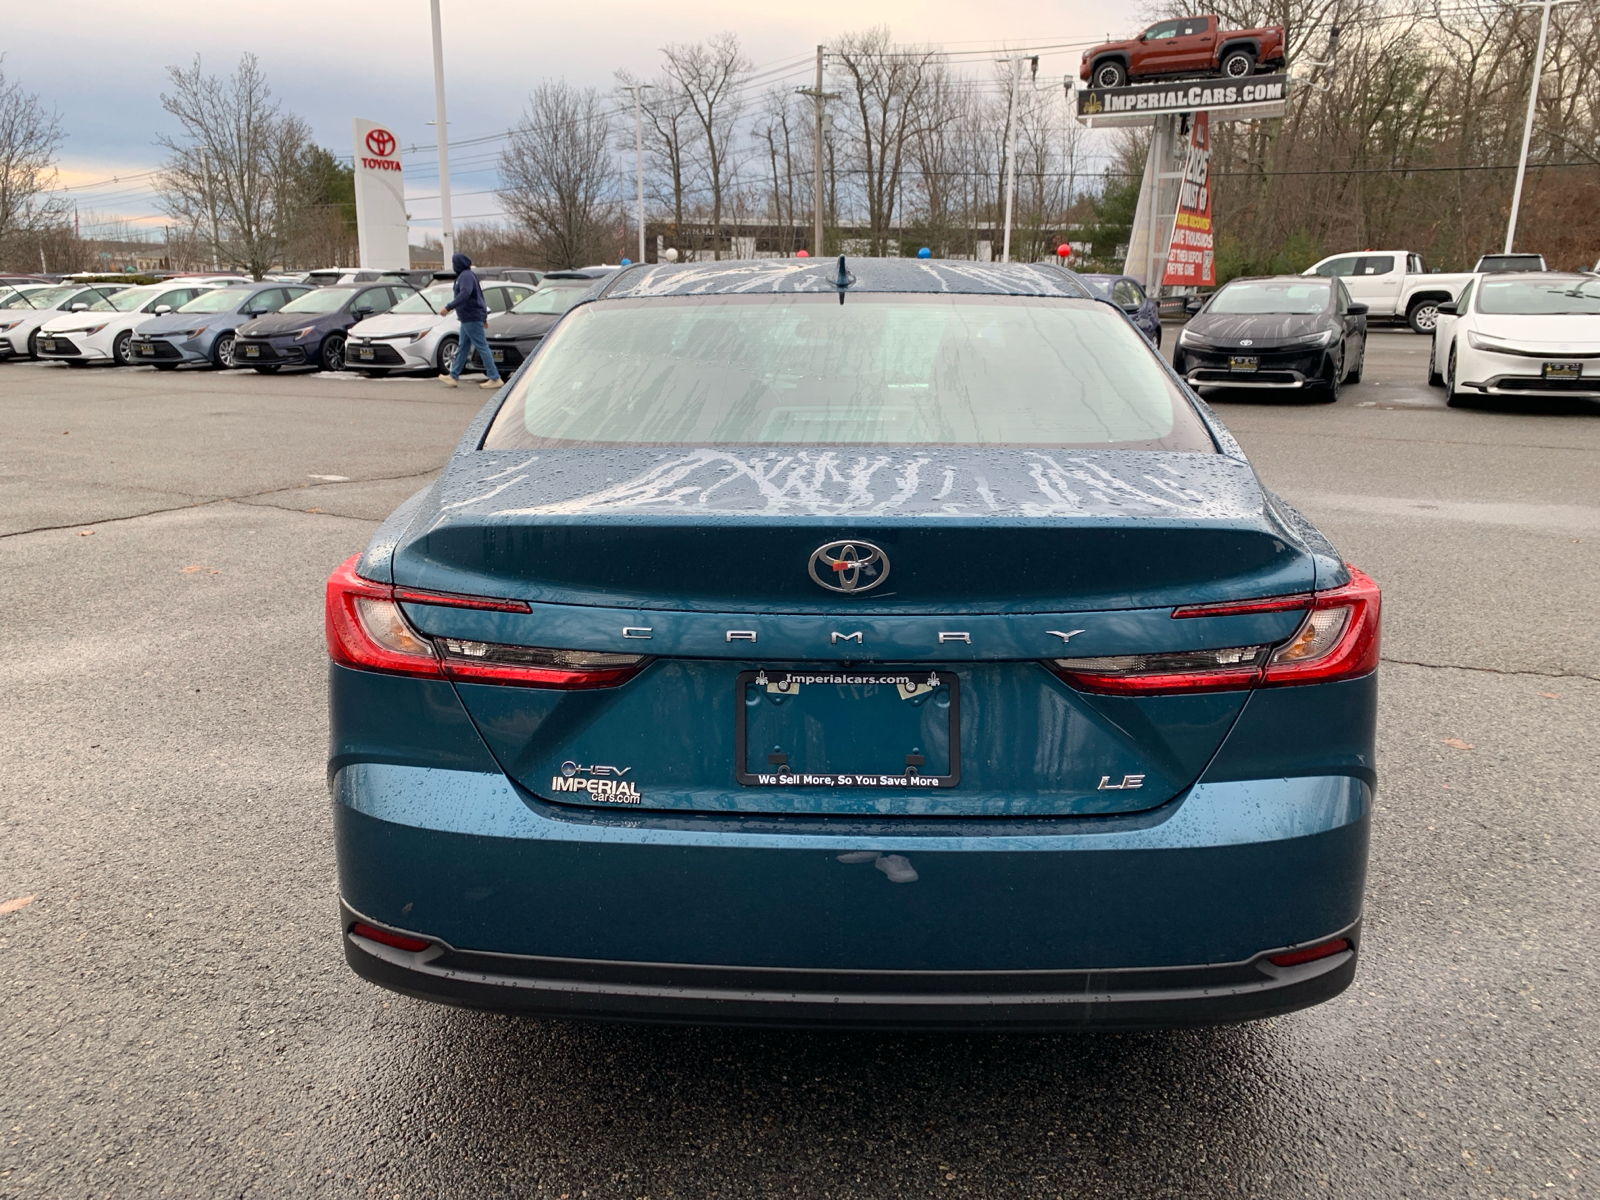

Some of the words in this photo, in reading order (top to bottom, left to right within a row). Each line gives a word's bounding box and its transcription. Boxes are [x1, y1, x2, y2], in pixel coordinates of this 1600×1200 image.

[361, 157, 402, 171] TOYOTA
[622, 626, 1086, 645] CAMRY
[786, 673, 910, 685] Imperialcars.com
[551, 776, 641, 796] IMPERIAL
[758, 775, 777, 785] We
[779, 774, 800, 785] Sell
[803, 775, 835, 787] More,
[837, 775, 852, 785] So
[855, 775, 877, 786] You
[879, 775, 907, 787] Save
[910, 776, 939, 786] More
[1097, 774, 1146, 790] LE
[591, 791, 640, 804] cars.com
